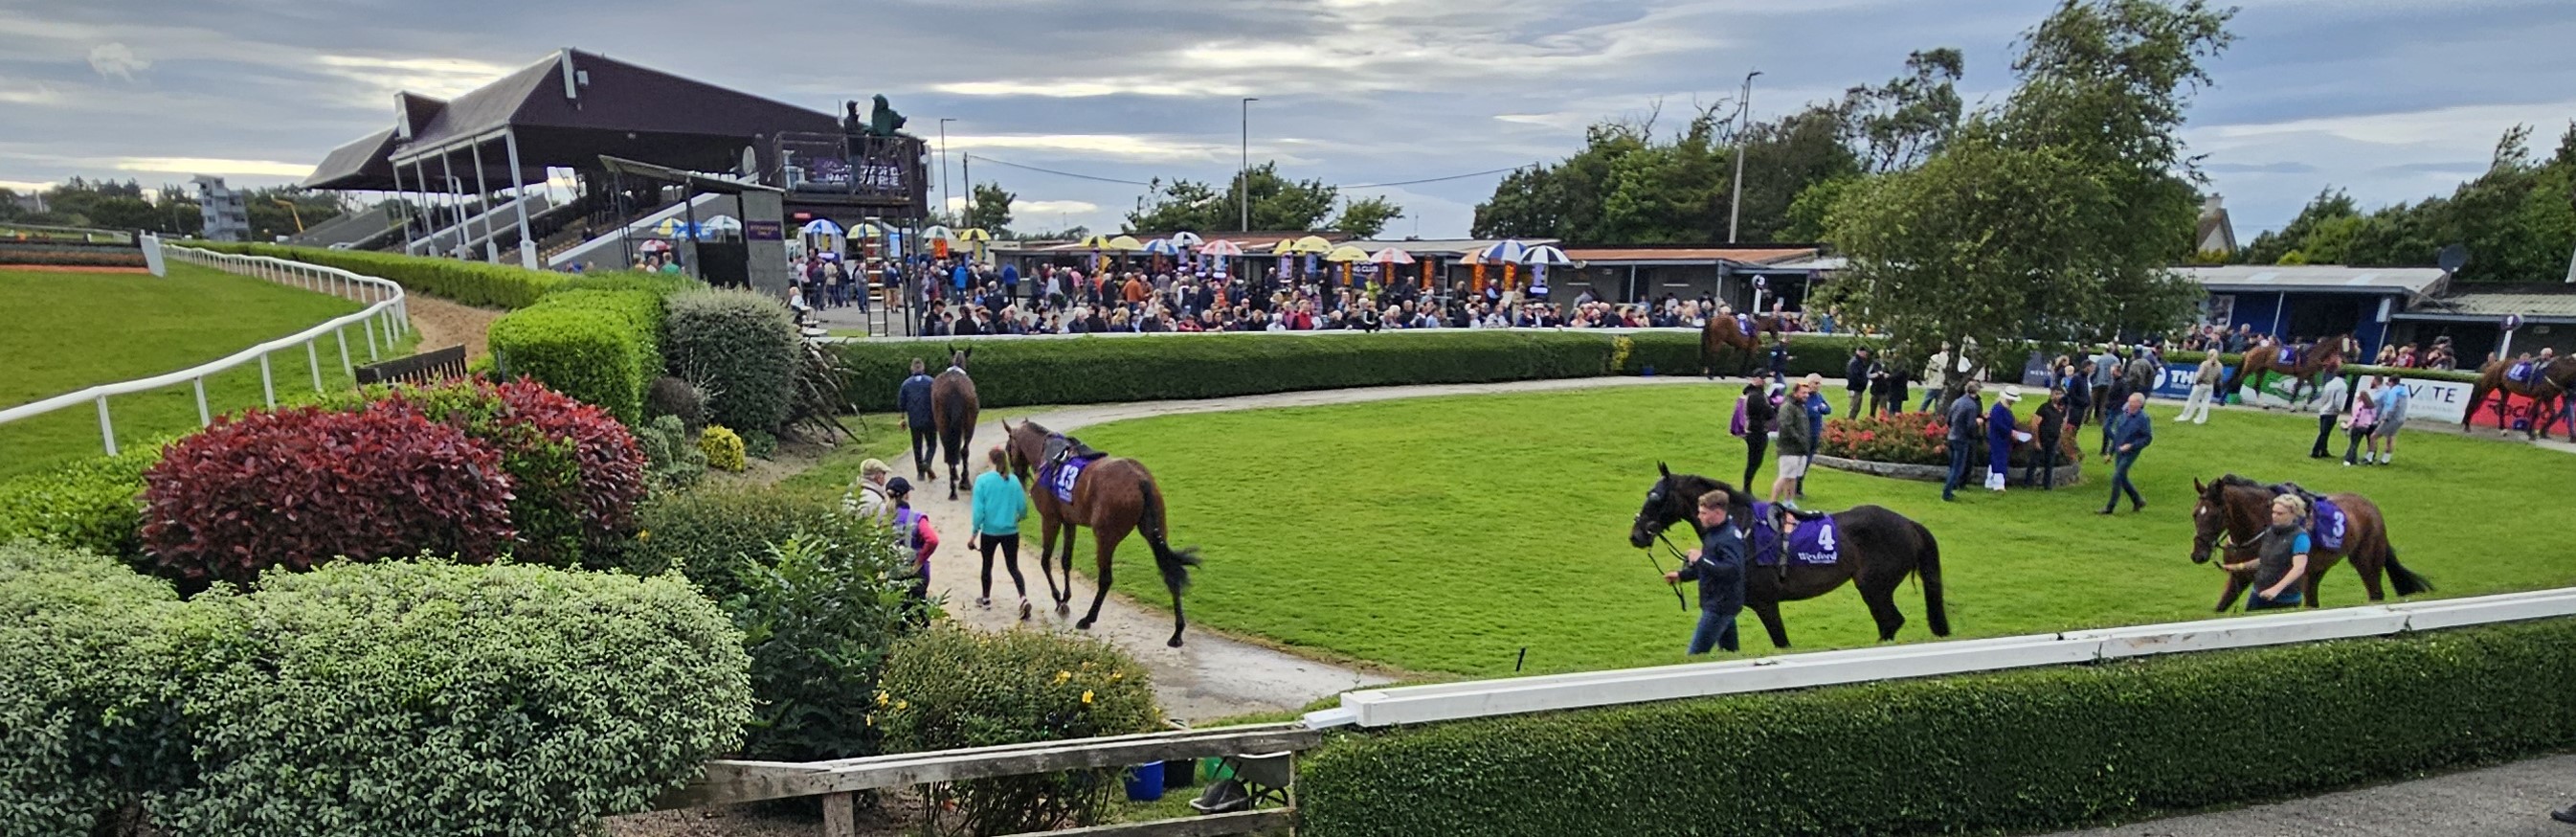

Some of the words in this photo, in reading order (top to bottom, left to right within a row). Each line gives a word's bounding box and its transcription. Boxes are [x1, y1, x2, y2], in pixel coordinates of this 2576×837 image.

[1057, 464, 1079, 490] 13
[2332, 510, 2345, 537] 3
[1817, 524, 1836, 551] 4
